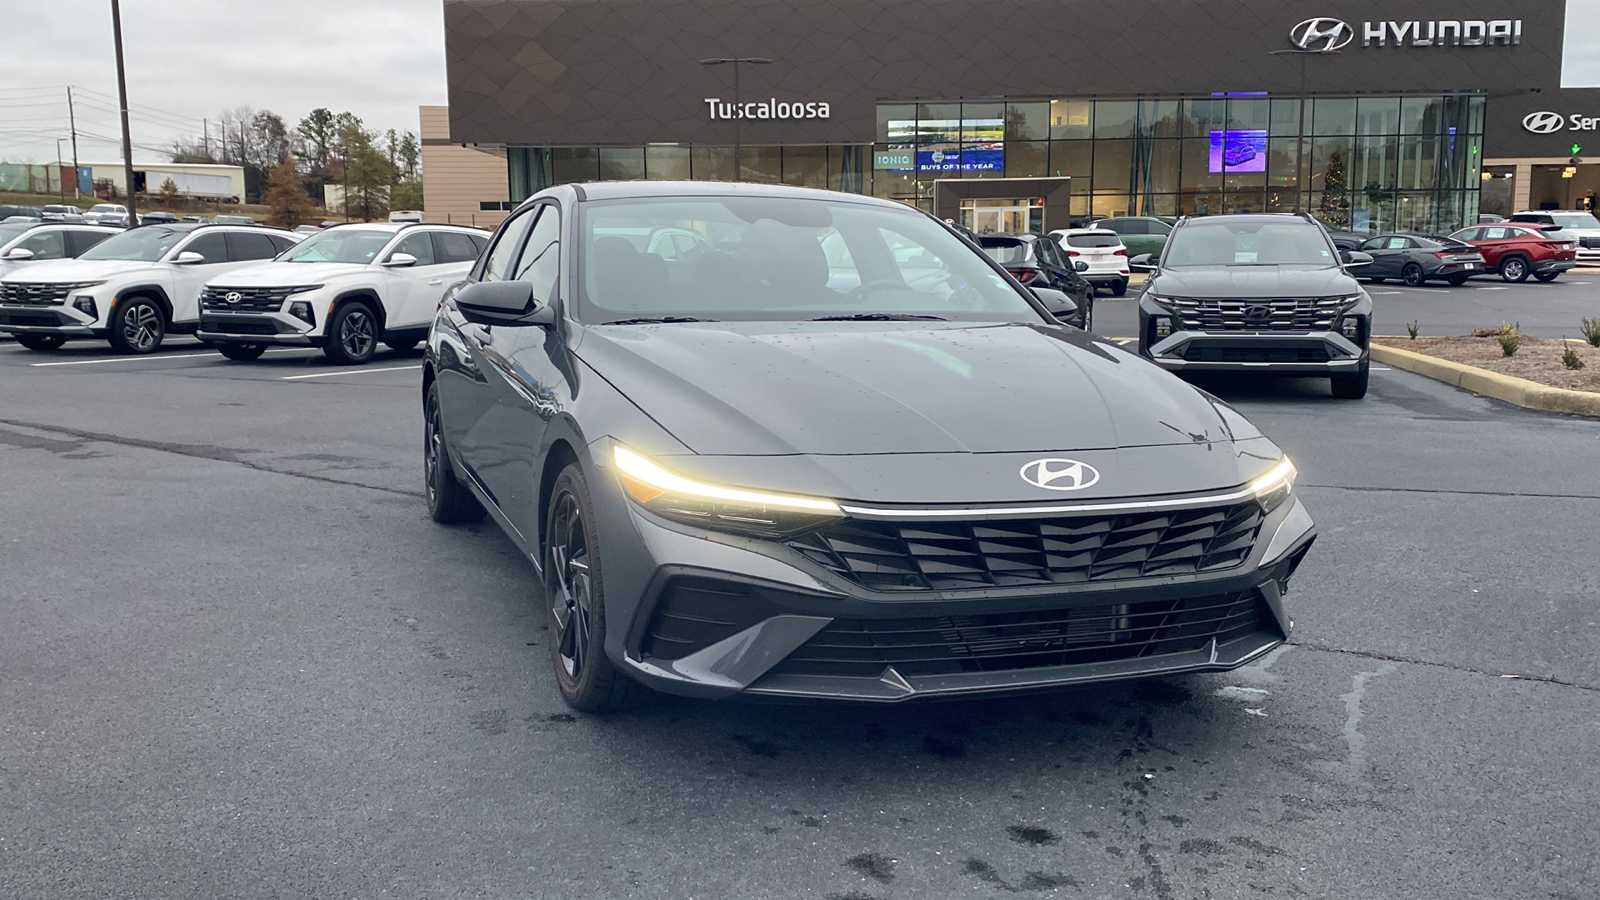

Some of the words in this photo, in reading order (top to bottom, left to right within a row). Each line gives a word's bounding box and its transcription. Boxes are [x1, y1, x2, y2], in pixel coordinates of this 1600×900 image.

[1362, 19, 1522, 47] HYUNDAI
[704, 98, 830, 119] Tuscaloosa
[878, 156, 909, 164] IONIQ
